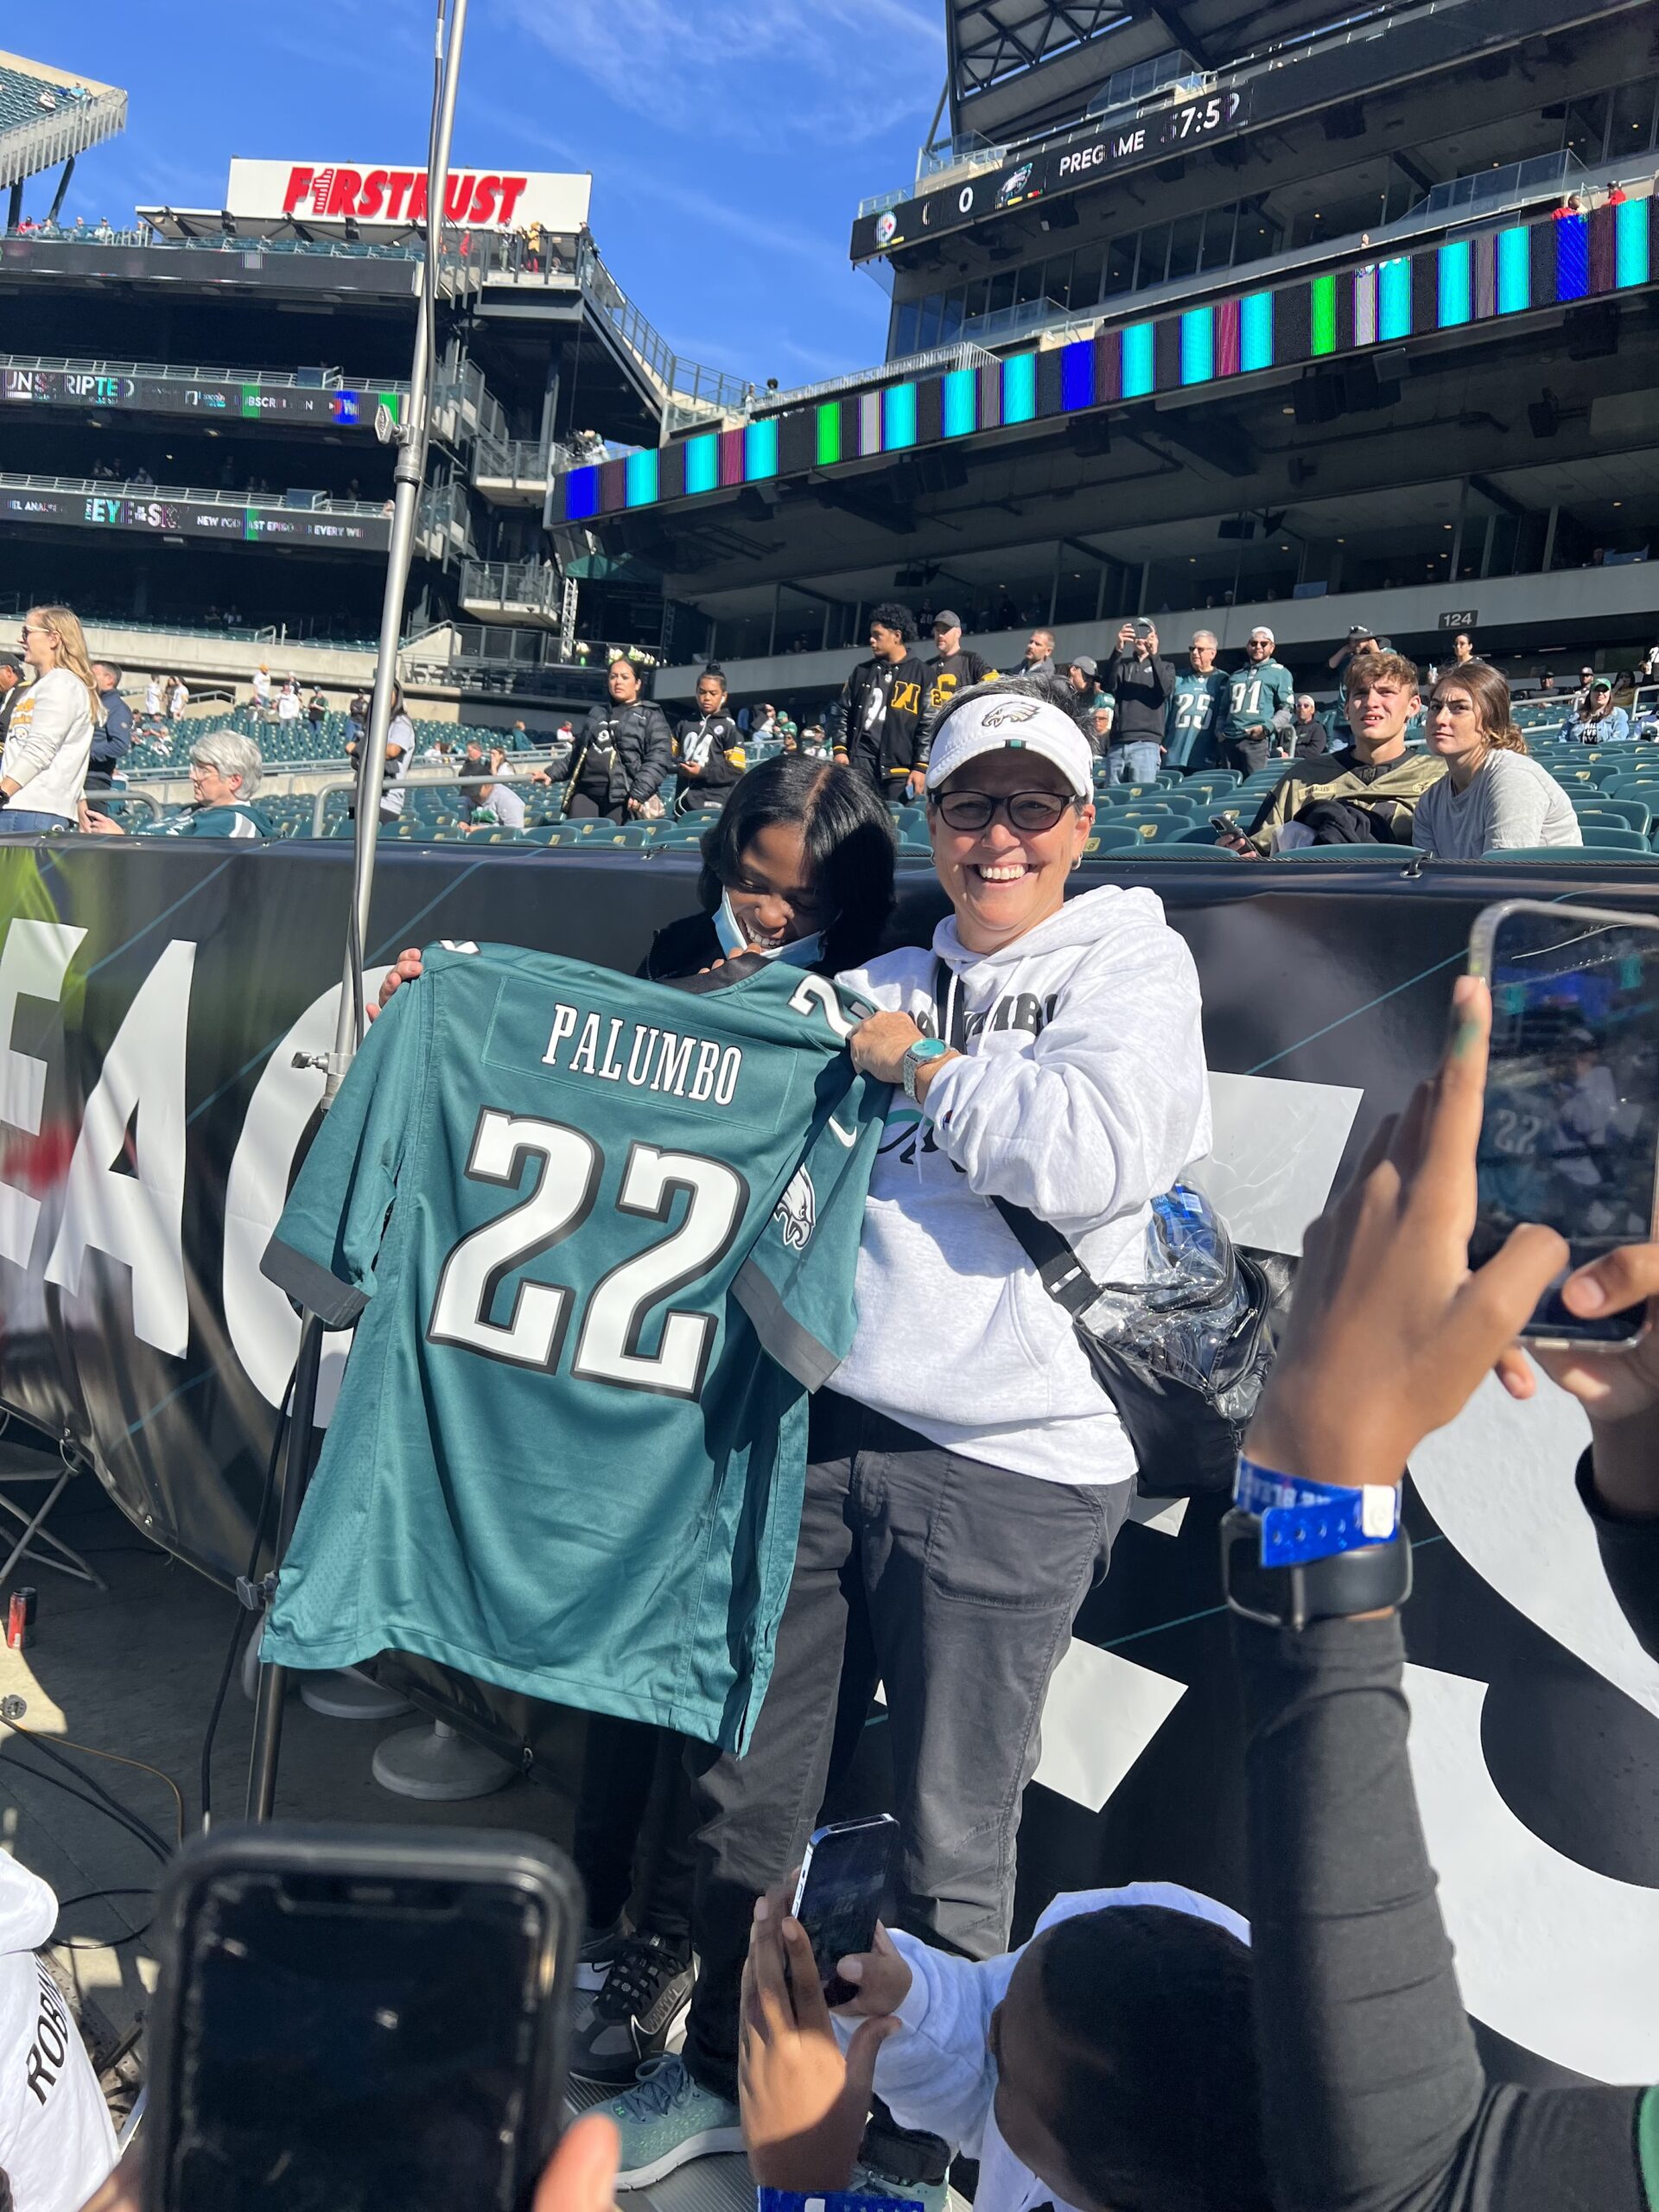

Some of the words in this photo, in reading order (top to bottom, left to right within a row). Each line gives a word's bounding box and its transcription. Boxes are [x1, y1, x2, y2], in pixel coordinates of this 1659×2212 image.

[197, 515, 219, 526] NEW
[1444, 613, 1472, 627] 124
[1175, 693, 1213, 730] 25
[1230, 680, 1262, 715] 91
[541, 1001, 744, 1106] PALUMBO
[427, 1105, 750, 1403] 22
